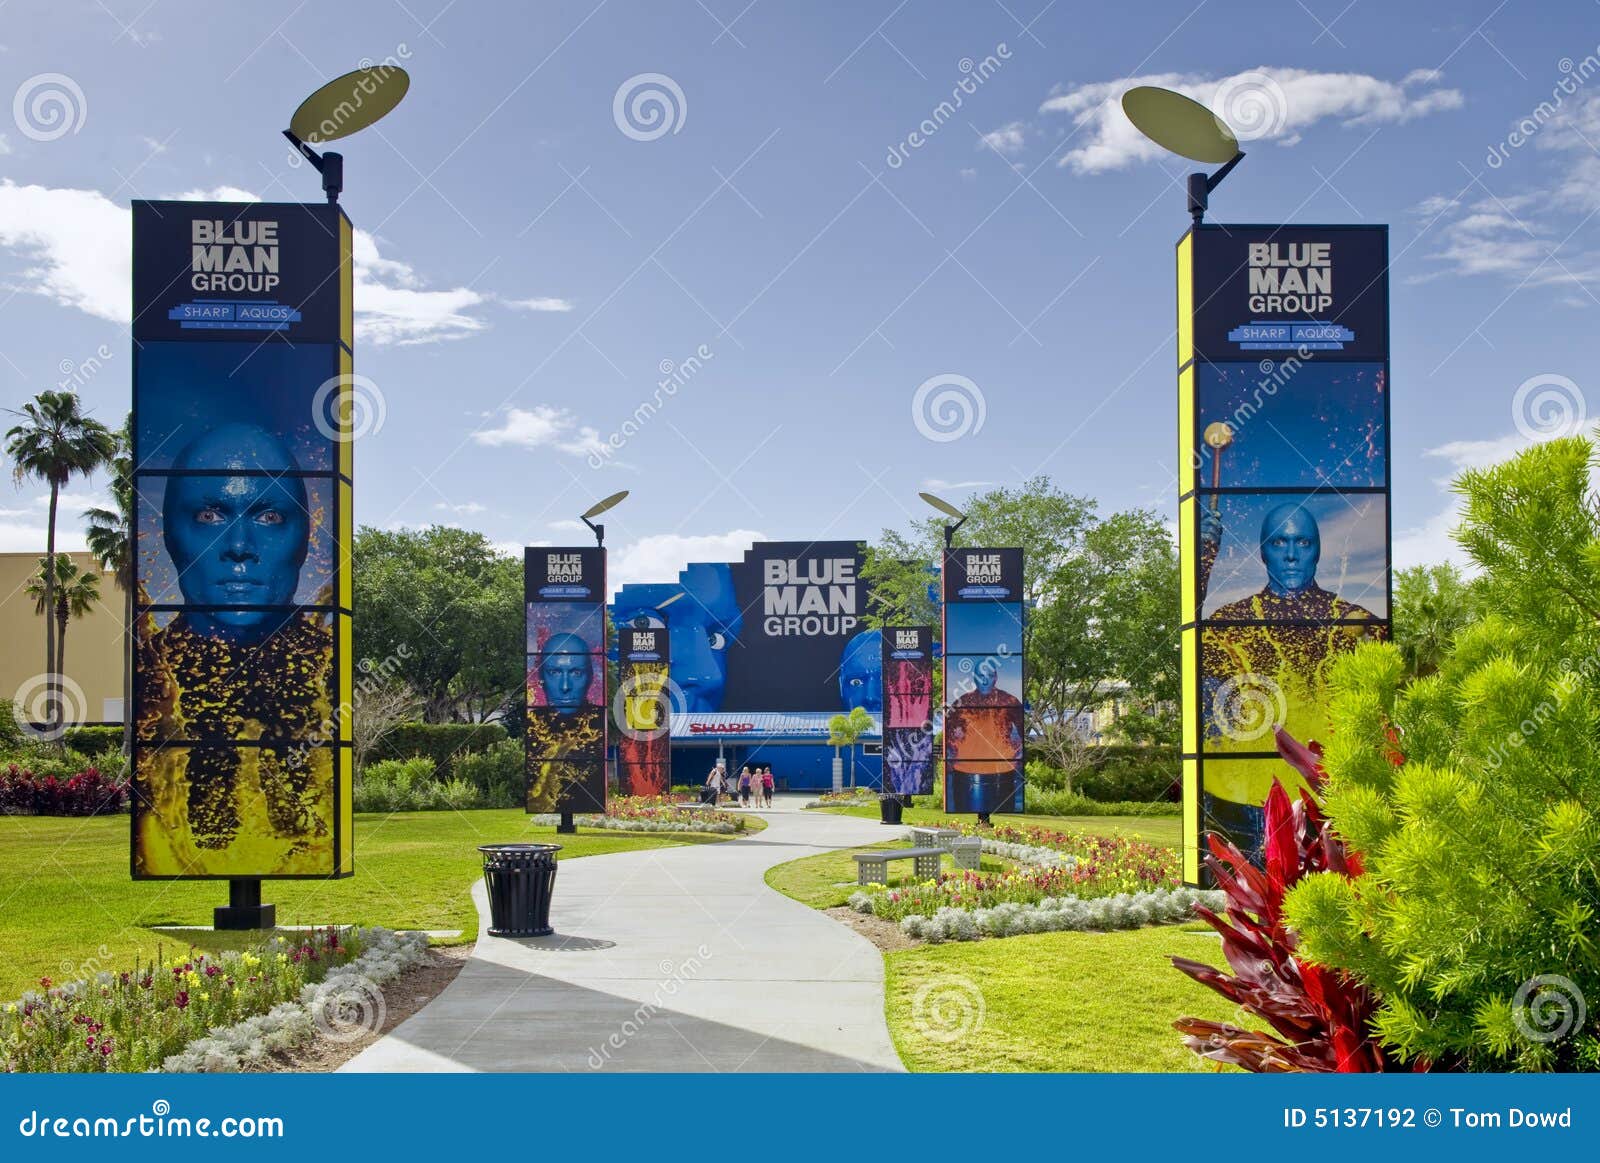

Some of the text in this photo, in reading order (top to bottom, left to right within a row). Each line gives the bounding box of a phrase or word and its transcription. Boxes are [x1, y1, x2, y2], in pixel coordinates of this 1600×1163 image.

[191, 219, 279, 245] BLUE
[191, 245, 279, 273] MAN
[1248, 242, 1331, 267] BLUE
[191, 273, 280, 292] GROUP
[1249, 268, 1332, 294] MAN
[1248, 295, 1333, 313] GROUP
[184, 306, 289, 319] SHARP AQUOS
[1243, 328, 1341, 339] SHARP AQUOS
[547, 553, 582, 564] BLUE
[966, 554, 1001, 564] BLUE
[547, 564, 582, 575] MAN
[763, 558, 856, 585] BLUE
[966, 564, 1001, 576] MAN
[547, 575, 583, 583] GROUP
[966, 575, 1002, 583] GROUP
[763, 585, 856, 615] MAN
[763, 616, 857, 636] GROUP
[632, 638, 655, 646] MAN
[689, 723, 755, 733] SHARP
